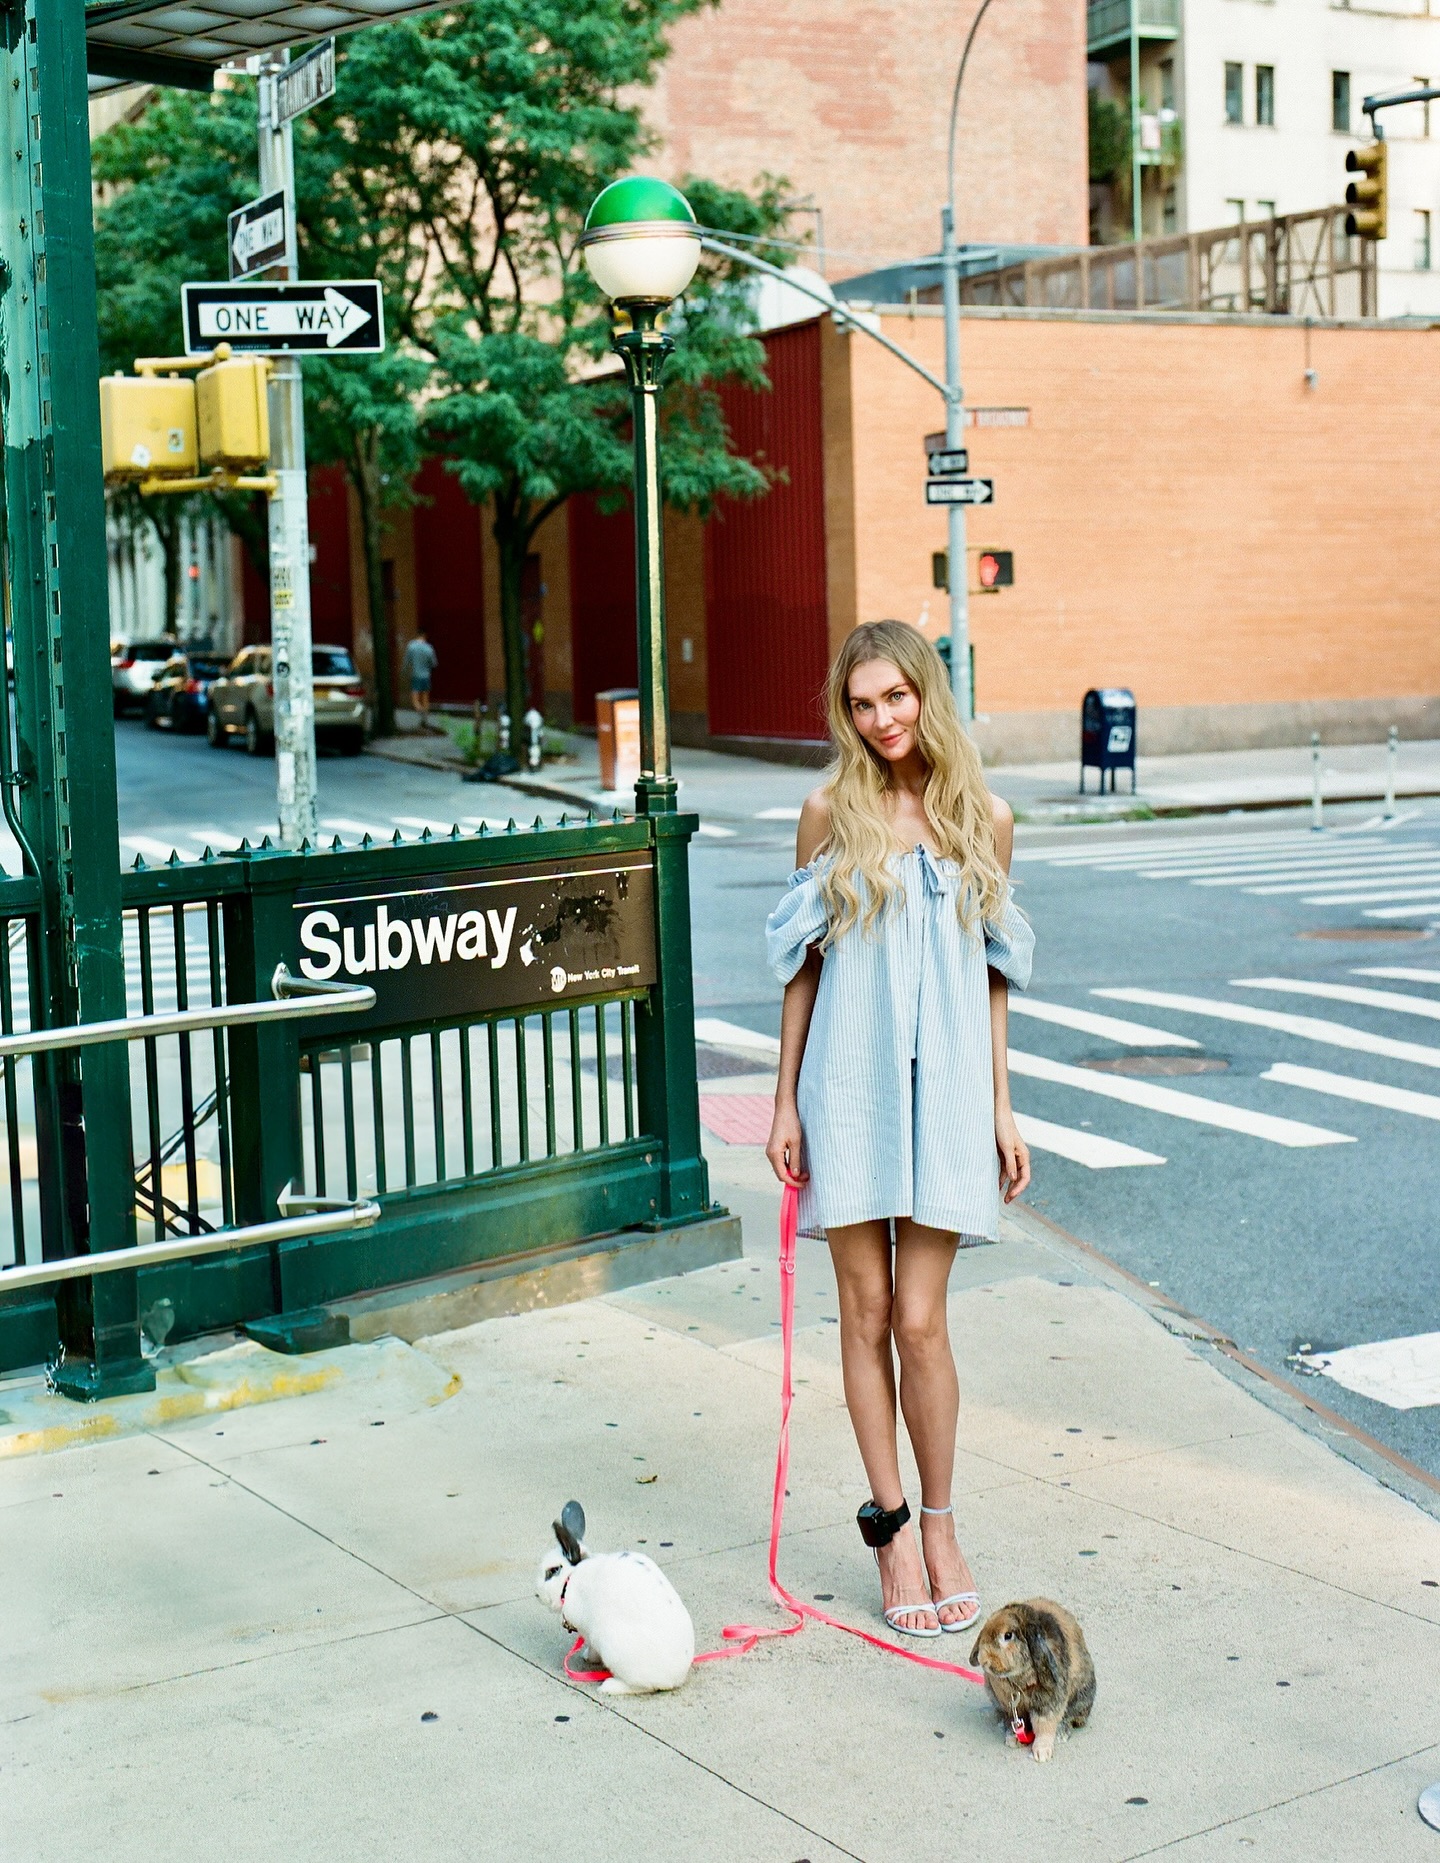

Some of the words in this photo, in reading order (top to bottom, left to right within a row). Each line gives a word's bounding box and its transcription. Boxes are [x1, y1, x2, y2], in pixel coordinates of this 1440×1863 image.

[216, 307, 269, 332] ONE
[296, 305, 350, 330] WAY
[299, 905, 518, 980] Subway
[567, 972, 584, 983] New
[584, 969, 600, 980] York
[601, 967, 616, 979] City
[617, 964, 640, 976] Transit
